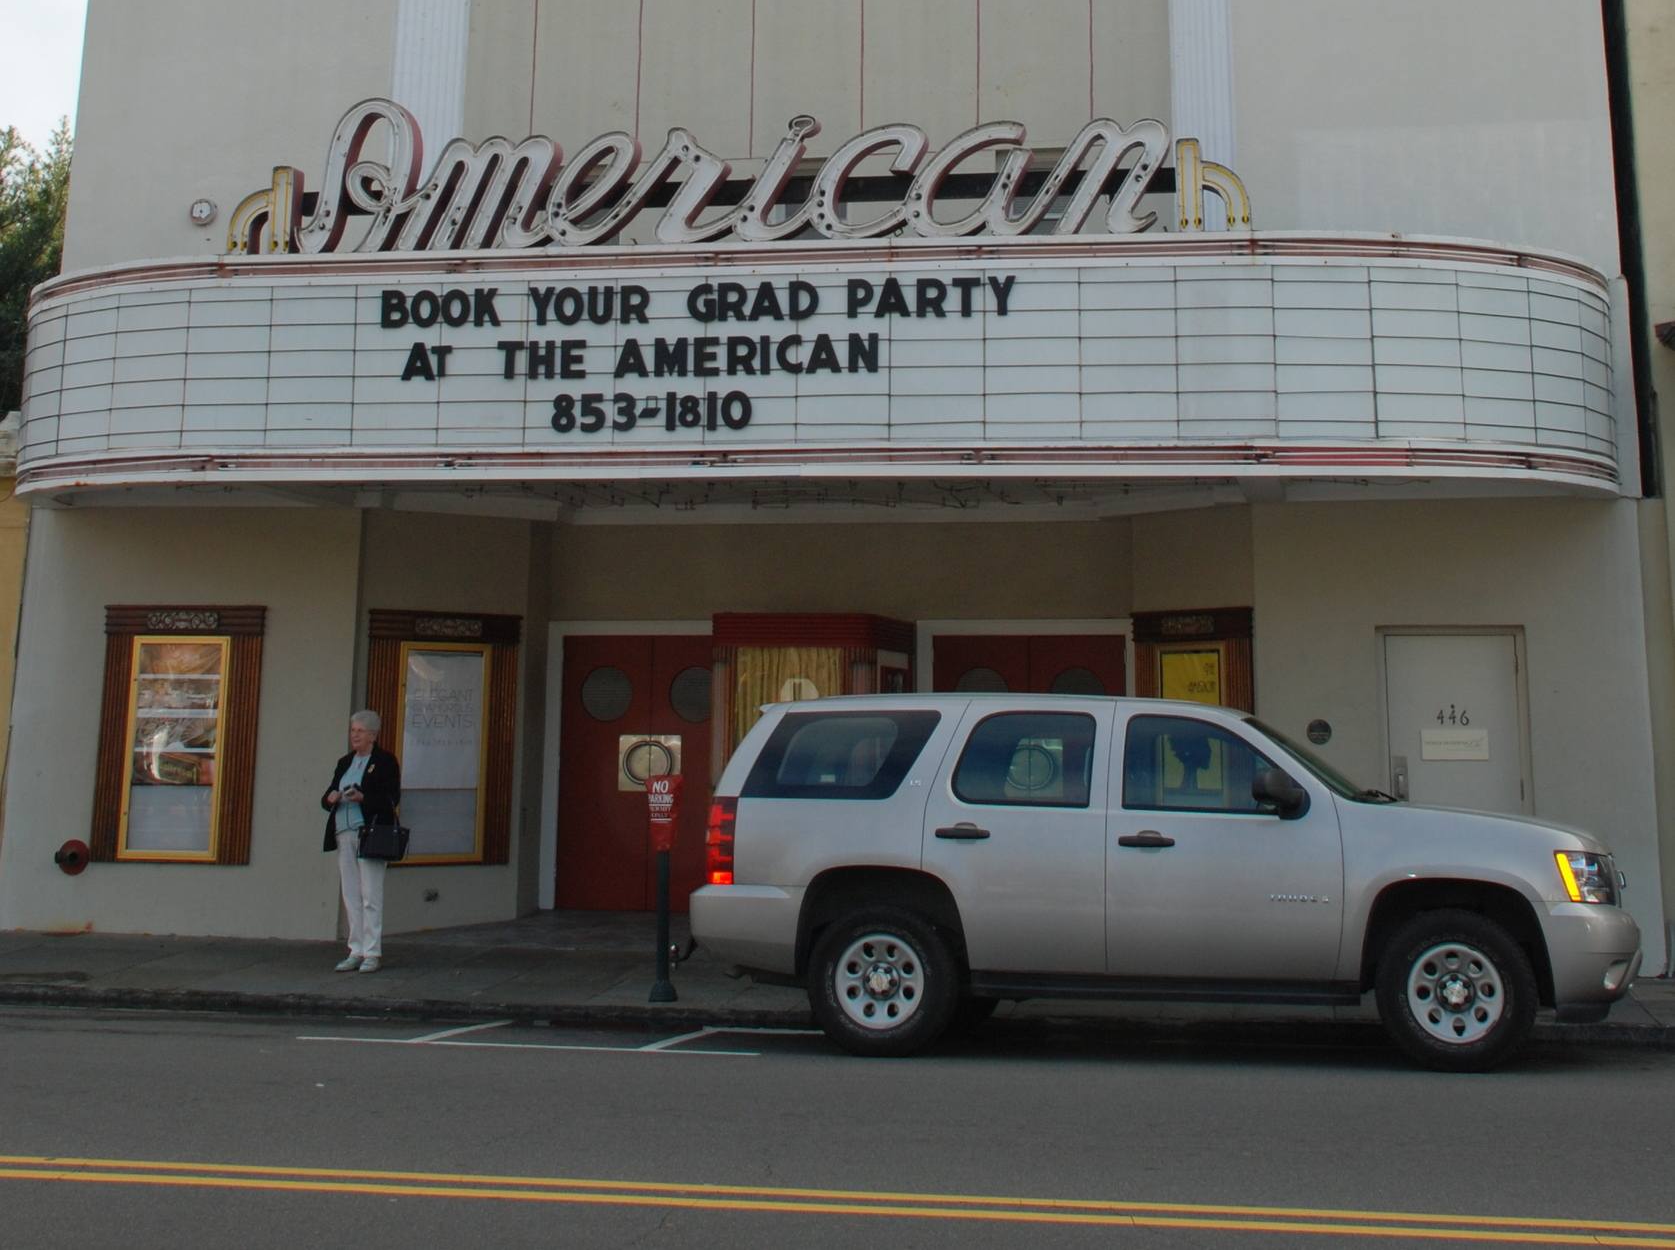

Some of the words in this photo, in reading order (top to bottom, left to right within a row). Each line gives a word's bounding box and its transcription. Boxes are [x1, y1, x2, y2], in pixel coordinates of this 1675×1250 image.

[295, 97, 1170, 253] American
[379, 287, 502, 329] BOOK
[523, 285, 650, 326] YOUR
[686, 280, 820, 324] GRAD
[846, 275, 1016, 319] PARTY
[400, 342, 454, 382] AT
[496, 339, 590, 380] THE
[612, 332, 880, 379] AMERICAN
[551, 390, 753, 434] 853-1810
[412, 714, 473, 728] EVENTS
[1436, 709, 1470, 726] 446
[652, 780, 669, 793] NO
